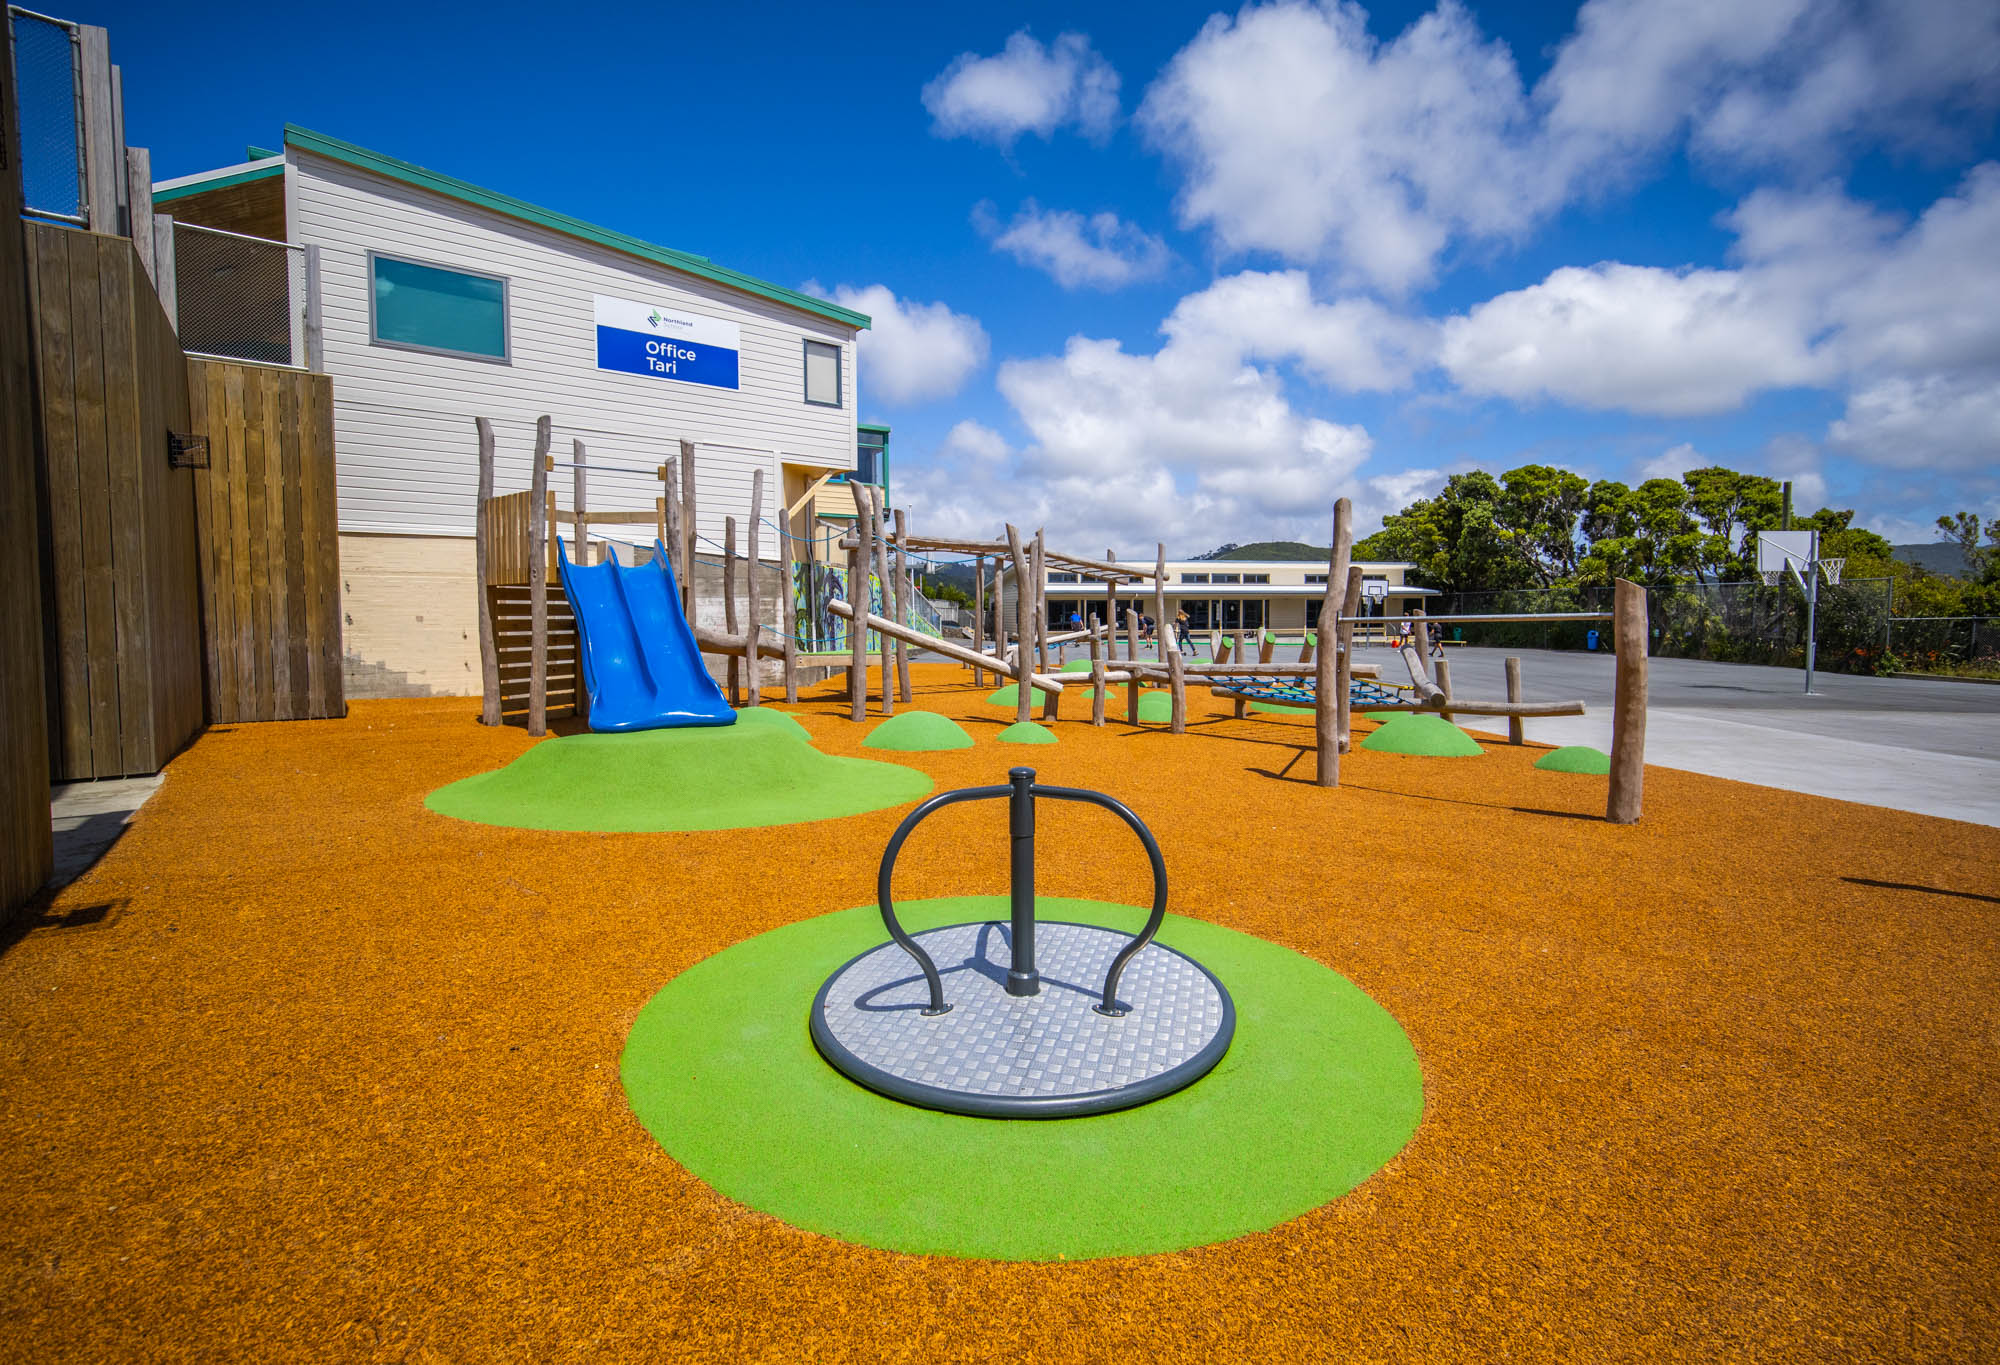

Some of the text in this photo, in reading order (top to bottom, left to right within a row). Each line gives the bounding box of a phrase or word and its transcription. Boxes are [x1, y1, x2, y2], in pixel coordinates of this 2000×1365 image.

[663, 316, 693, 327] Northland
[645, 341, 696, 361] Office
[646, 356, 677, 374] Tari
